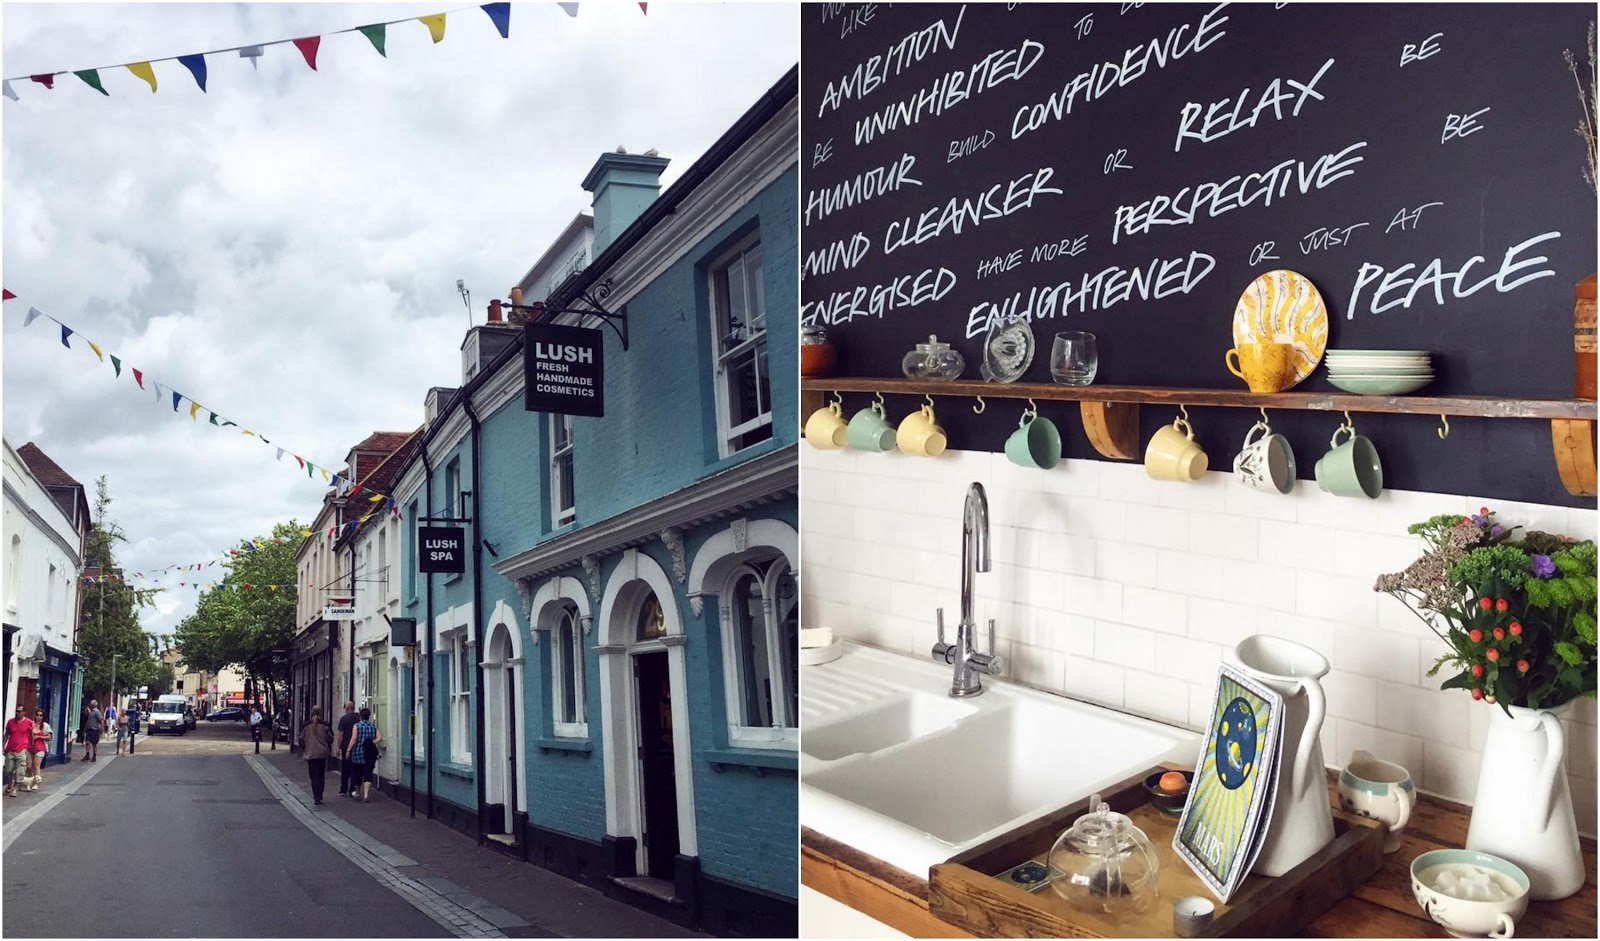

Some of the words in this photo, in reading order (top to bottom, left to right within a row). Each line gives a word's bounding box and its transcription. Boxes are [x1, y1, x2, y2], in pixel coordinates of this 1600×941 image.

[841, 4, 877, 39] LIKE
[819, 4, 966, 118] AMBITION
[813, 138, 833, 168] BE
[855, 39, 1044, 145] UNINHIBITED
[1074, 13, 1093, 39] TO
[805, 153, 922, 226] HUMOUR
[947, 130, 995, 163] BUILD
[1012, 4, 1229, 139] CONFIDENCE
[801, 230, 870, 281] MIND
[884, 168, 1063, 254] CLEANSER
[1104, 149, 1133, 174] OR
[1175, 58, 1335, 152] RELAX
[1400, 33, 1443, 67] BE
[801, 267, 957, 326] ENERGISED
[977, 249, 1023, 279] HAVE
[1031, 235, 1088, 262] MORE
[1113, 142, 1367, 245] PERSPECTIVE
[1441, 107, 1490, 144] BE
[966, 251, 1216, 339] ENLIGHTENED
[1249, 241, 1280, 266] OR
[1300, 222, 1369, 254] JUST
[1385, 202, 1443, 233] AT
[1347, 231, 1561, 320] PEACE
[536, 342, 593, 364] LUSH
[536, 361, 569, 373] FRESH
[536, 372, 593, 386] HANDMADE
[536, 383, 595, 397] COSMETICS
[426, 539, 458, 549] LUSH
[430, 551, 454, 561] SPA
[1192, 821, 1223, 866] MARS
